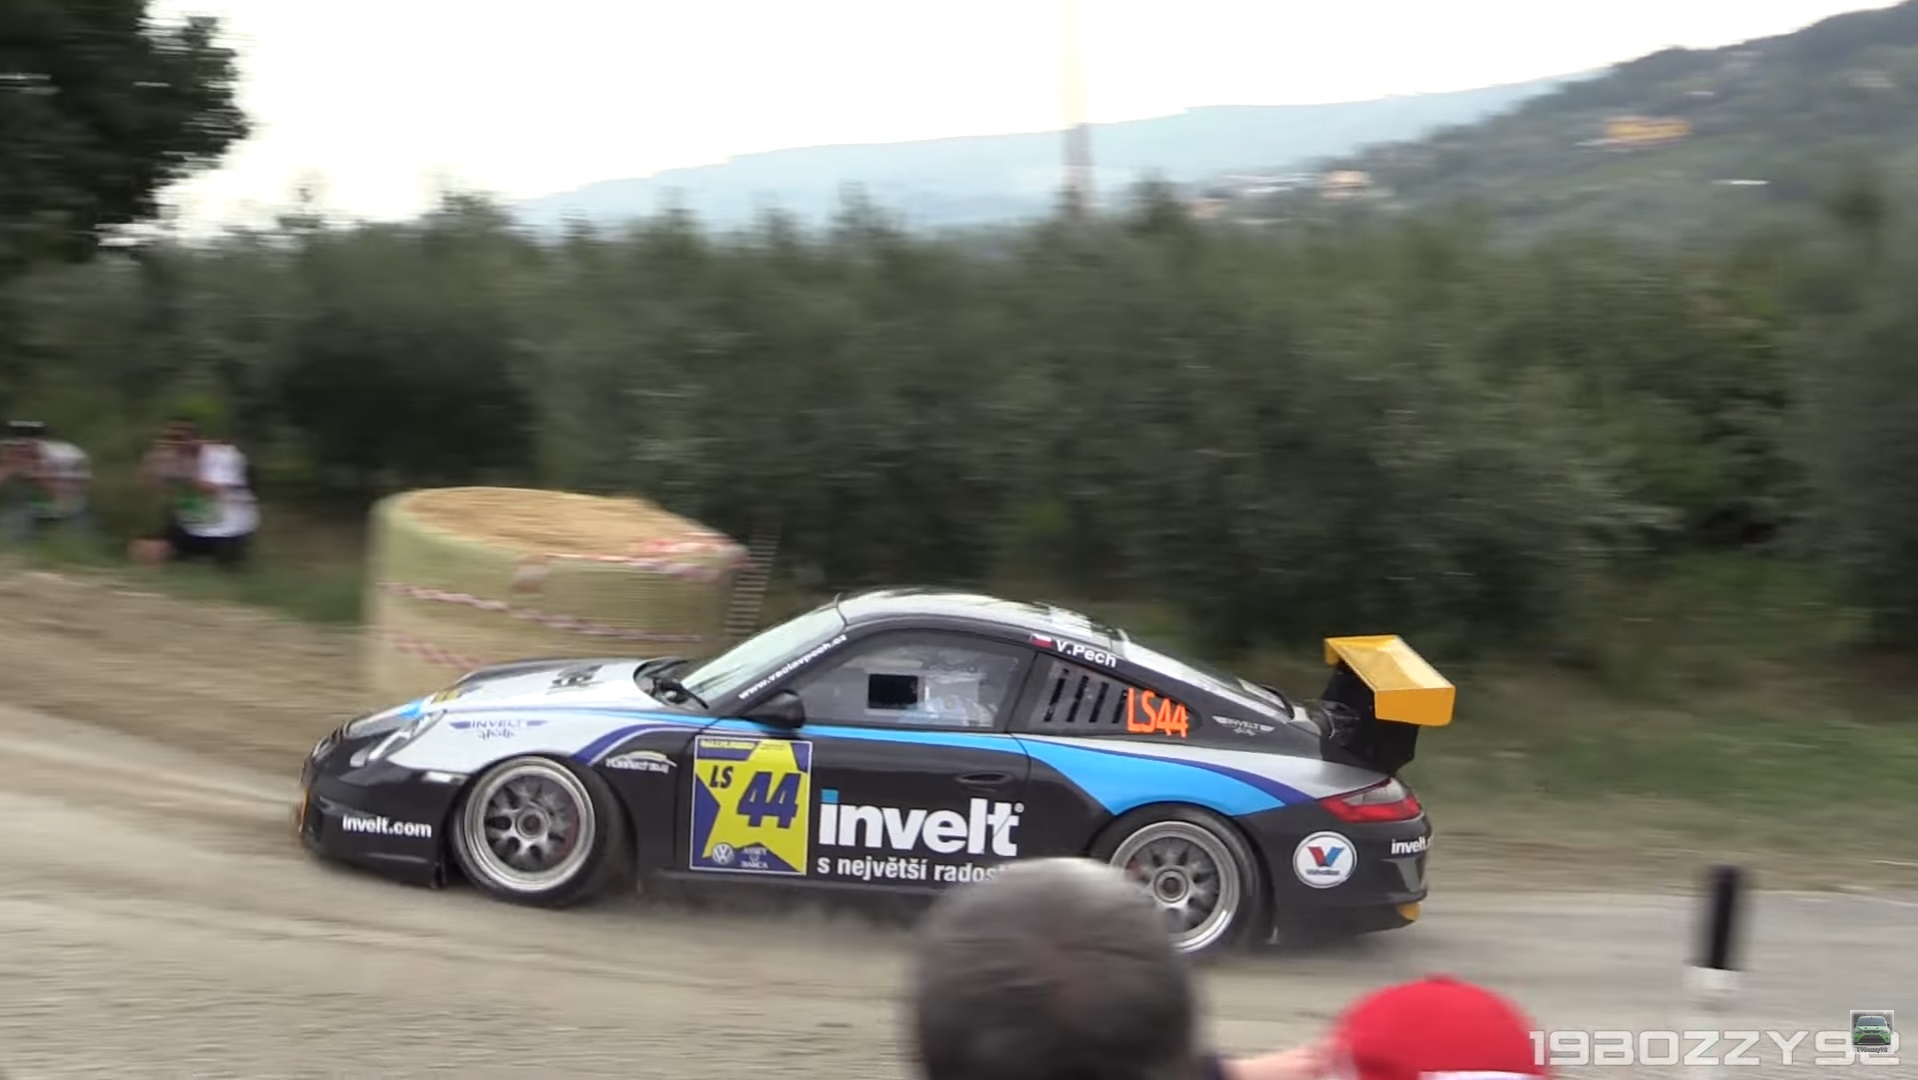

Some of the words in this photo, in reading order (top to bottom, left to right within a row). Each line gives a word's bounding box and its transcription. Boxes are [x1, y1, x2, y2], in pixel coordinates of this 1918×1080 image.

[1056, 639, 1117, 668] V.Pech
[1127, 687, 1189, 738] LS44
[709, 765, 734, 789] LS
[736, 770, 801, 830] 44
[342, 814, 432, 838] invelt.com
[817, 857, 830, 874] s
[837, 855, 928, 880] největší
[933, 863, 1003, 883] rados
